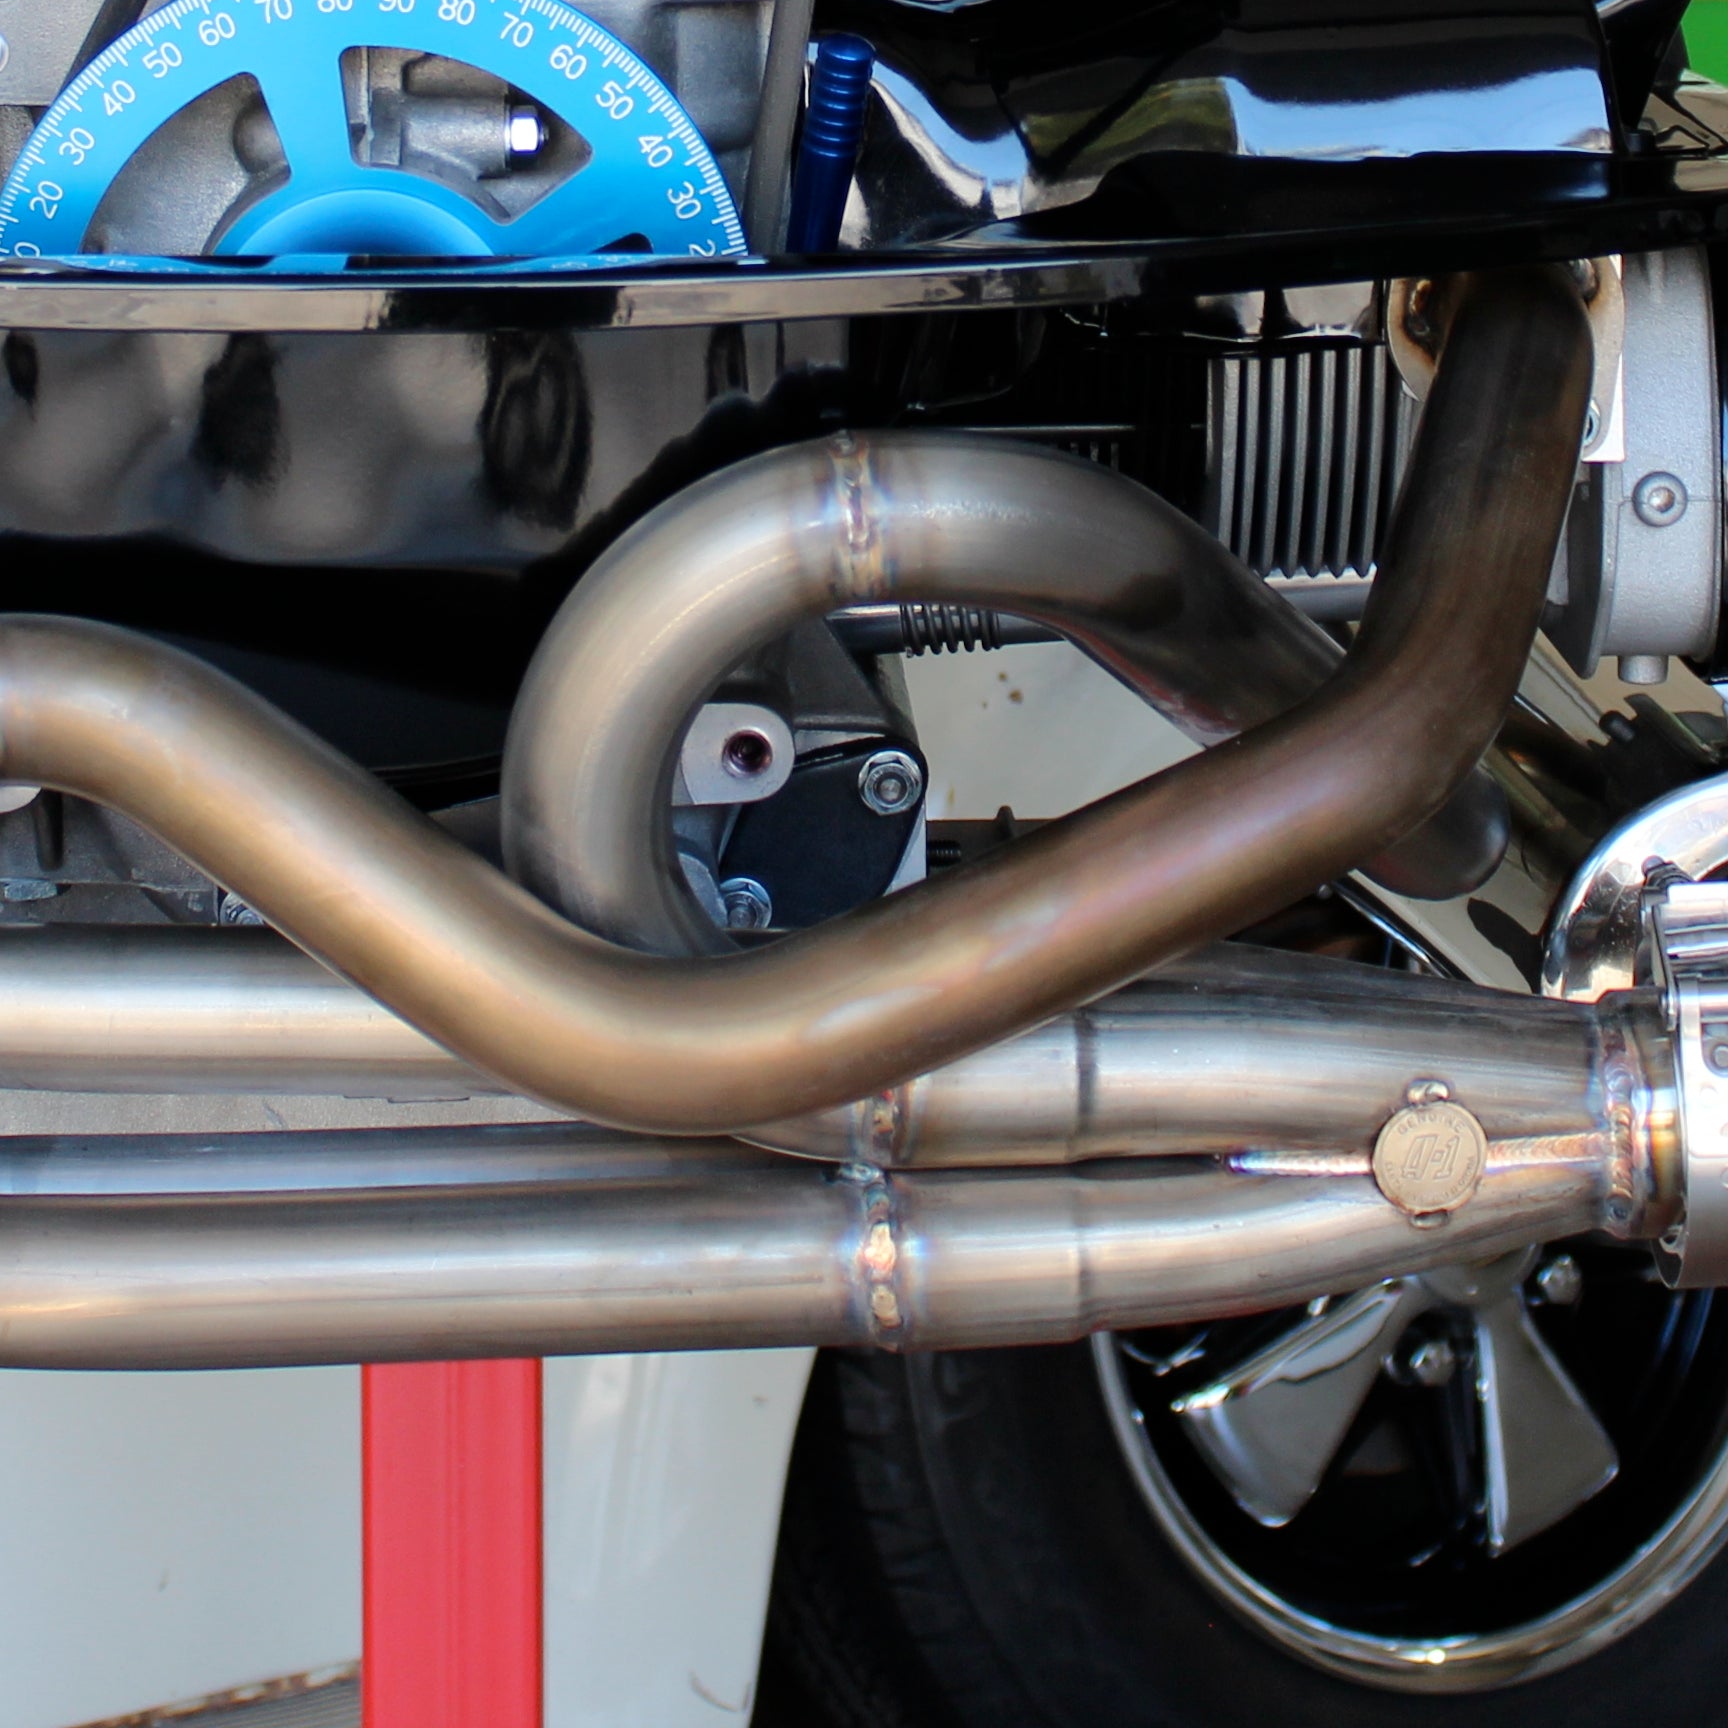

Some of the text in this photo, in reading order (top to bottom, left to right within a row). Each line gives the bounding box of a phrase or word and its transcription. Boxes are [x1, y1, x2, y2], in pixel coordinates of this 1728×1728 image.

[29, 180, 63, 219] 20
[58, 127, 95, 165] 30
[103, 79, 136, 116] 40
[142, 42, 183, 78] 50
[198, 12, 236, 46] 60
[499, 11, 534, 48] 70
[549, 44, 587, 80] 60
[595, 80, 634, 120] 50
[638, 134, 673, 168] 40
[666, 181, 702, 219] 30
